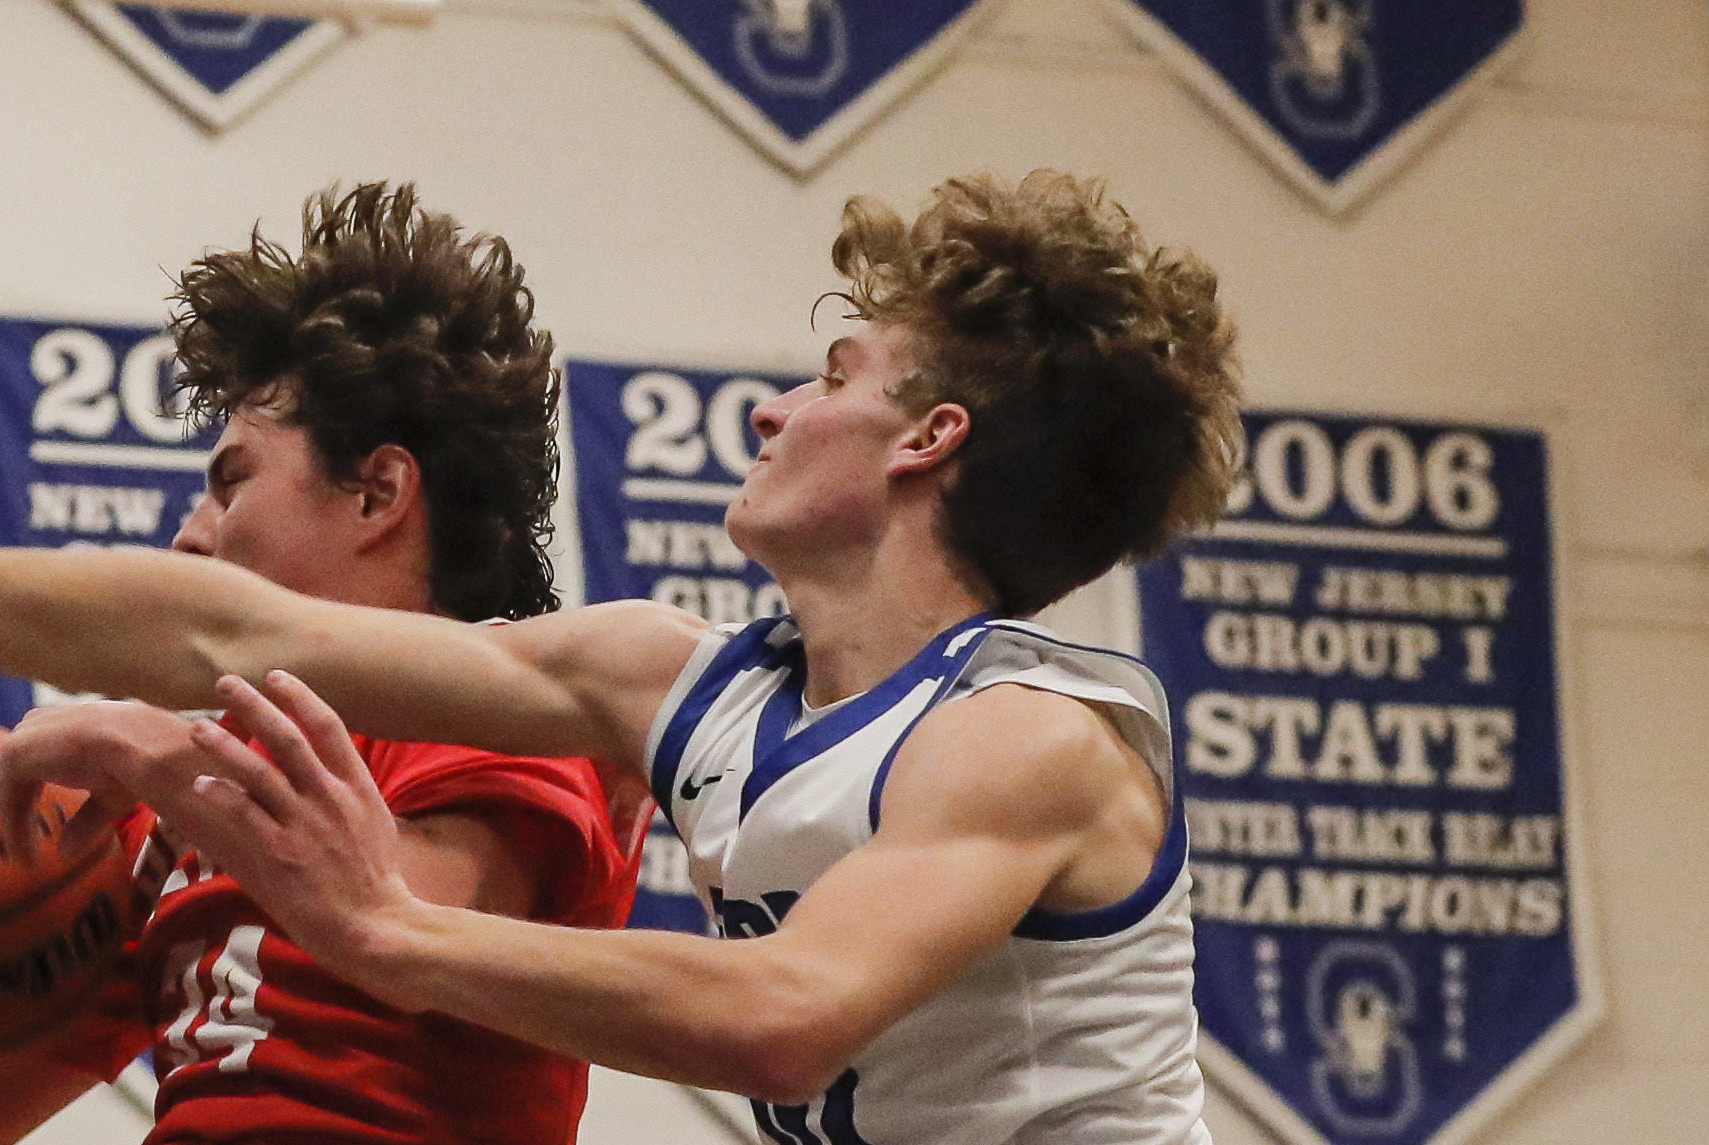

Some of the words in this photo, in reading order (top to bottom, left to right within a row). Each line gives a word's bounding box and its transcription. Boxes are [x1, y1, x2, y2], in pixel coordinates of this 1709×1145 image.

[28, 482, 165, 536] NEW
[1182, 556, 1299, 604] NEW
[1317, 565, 1511, 619] JERSEY
[1204, 613, 1440, 682] GROUP
[1462, 630, 1494, 684] I
[1187, 691, 1516, 790] STATE
